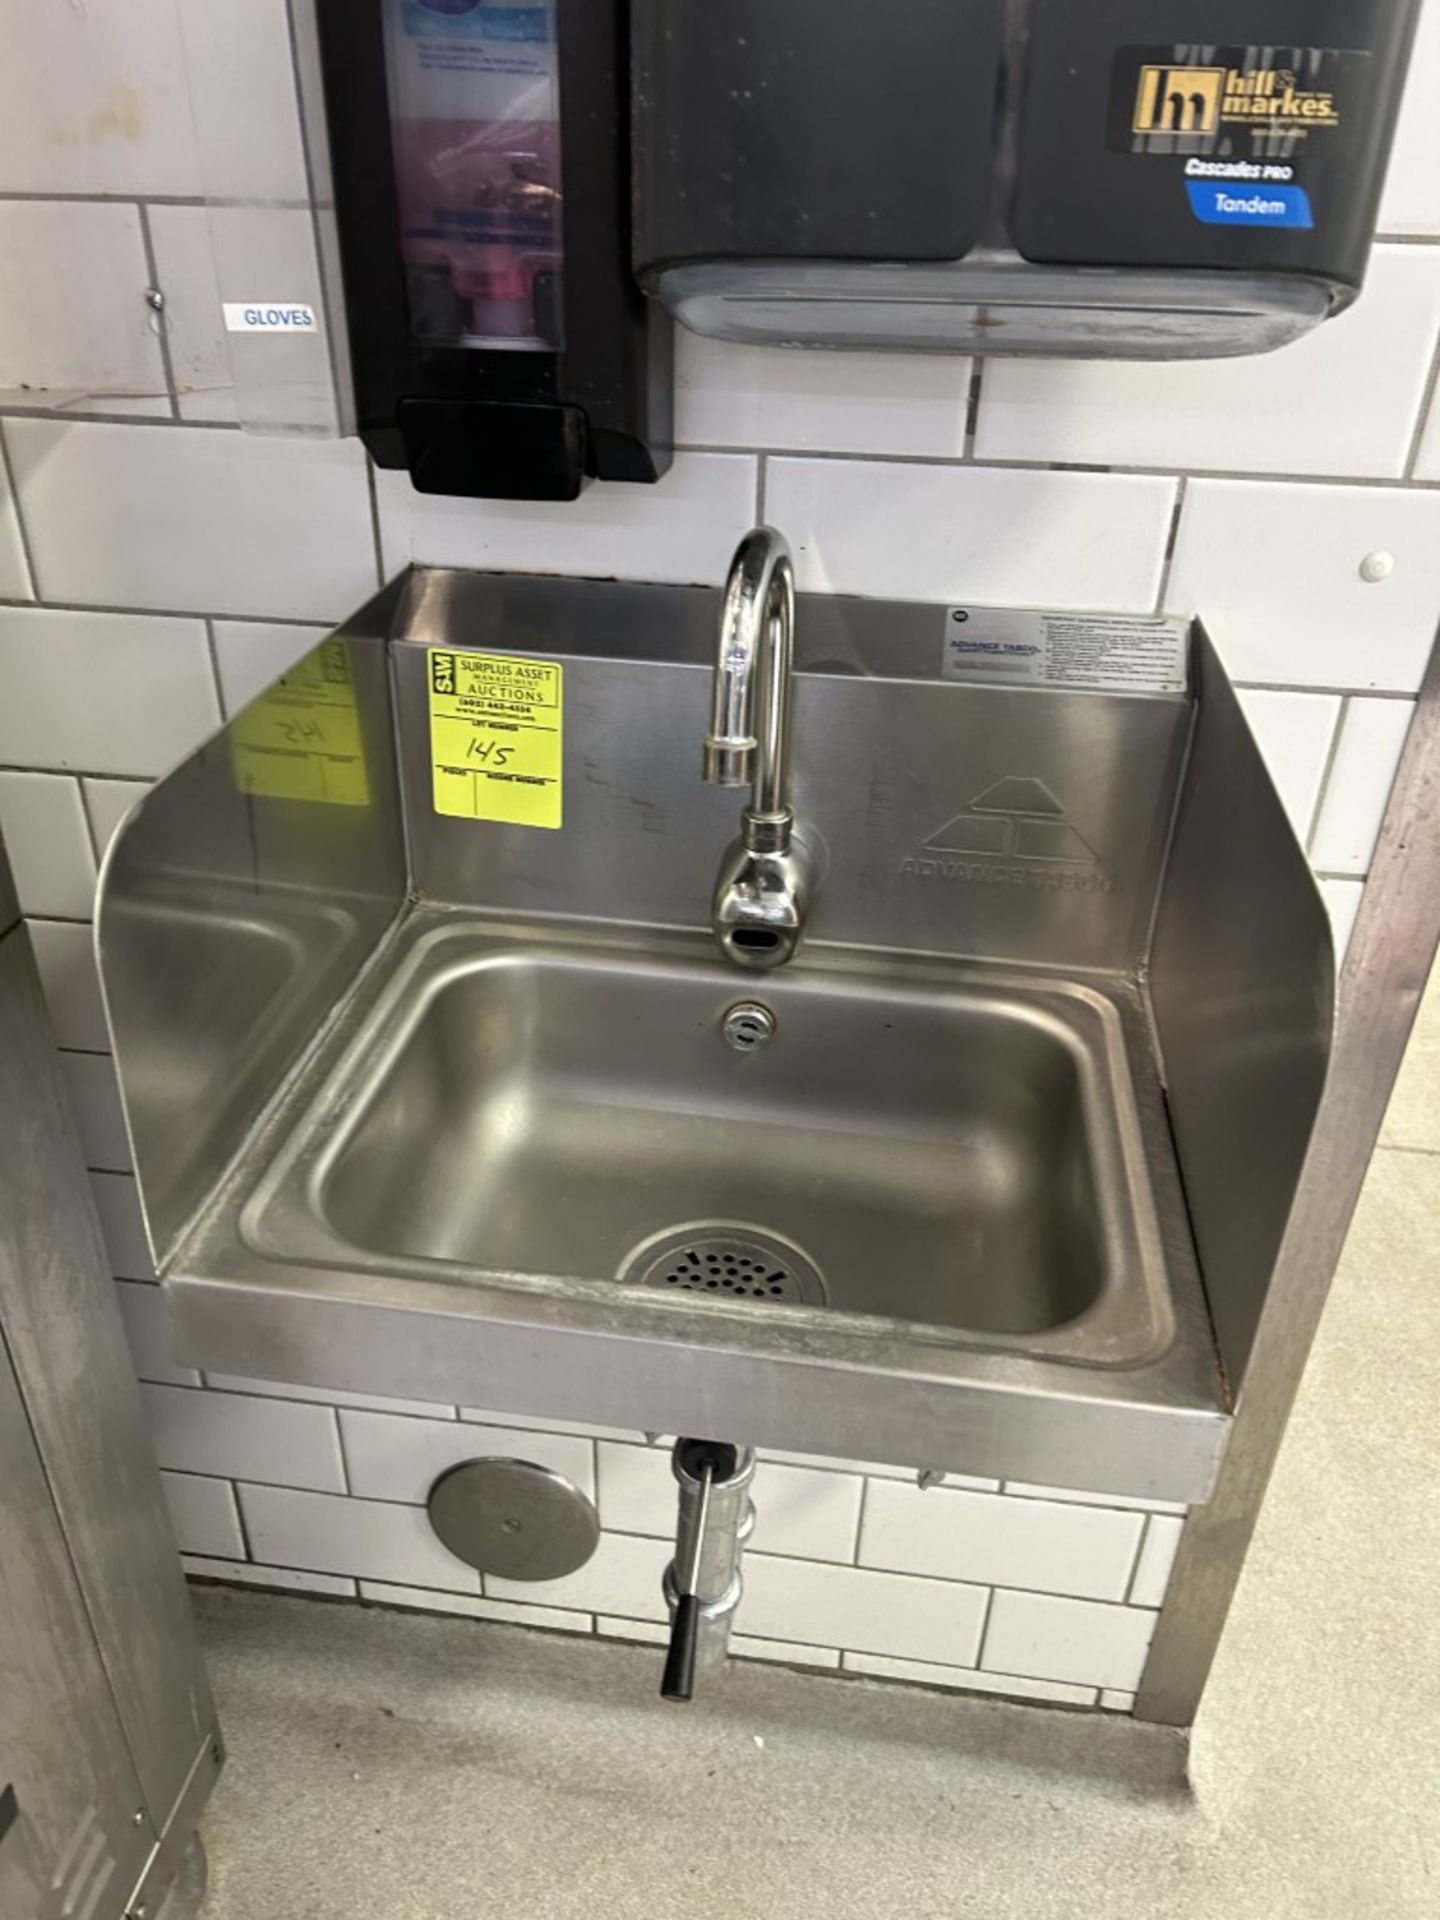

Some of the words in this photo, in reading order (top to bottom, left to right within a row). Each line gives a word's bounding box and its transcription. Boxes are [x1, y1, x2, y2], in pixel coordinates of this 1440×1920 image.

[1185, 158, 1262, 179] Cascades
[1262, 165, 1294, 180] PRO
[1214, 193, 1287, 215] Tandem
[244, 308, 313, 326] GLOVES
[461, 660, 513, 676] SURPLUS
[515, 667, 552, 682] ASSET
[473, 673, 540, 688] MANAGEMENT
[467, 684, 545, 703] AUCTIONS
[466, 737, 516, 766] 145
